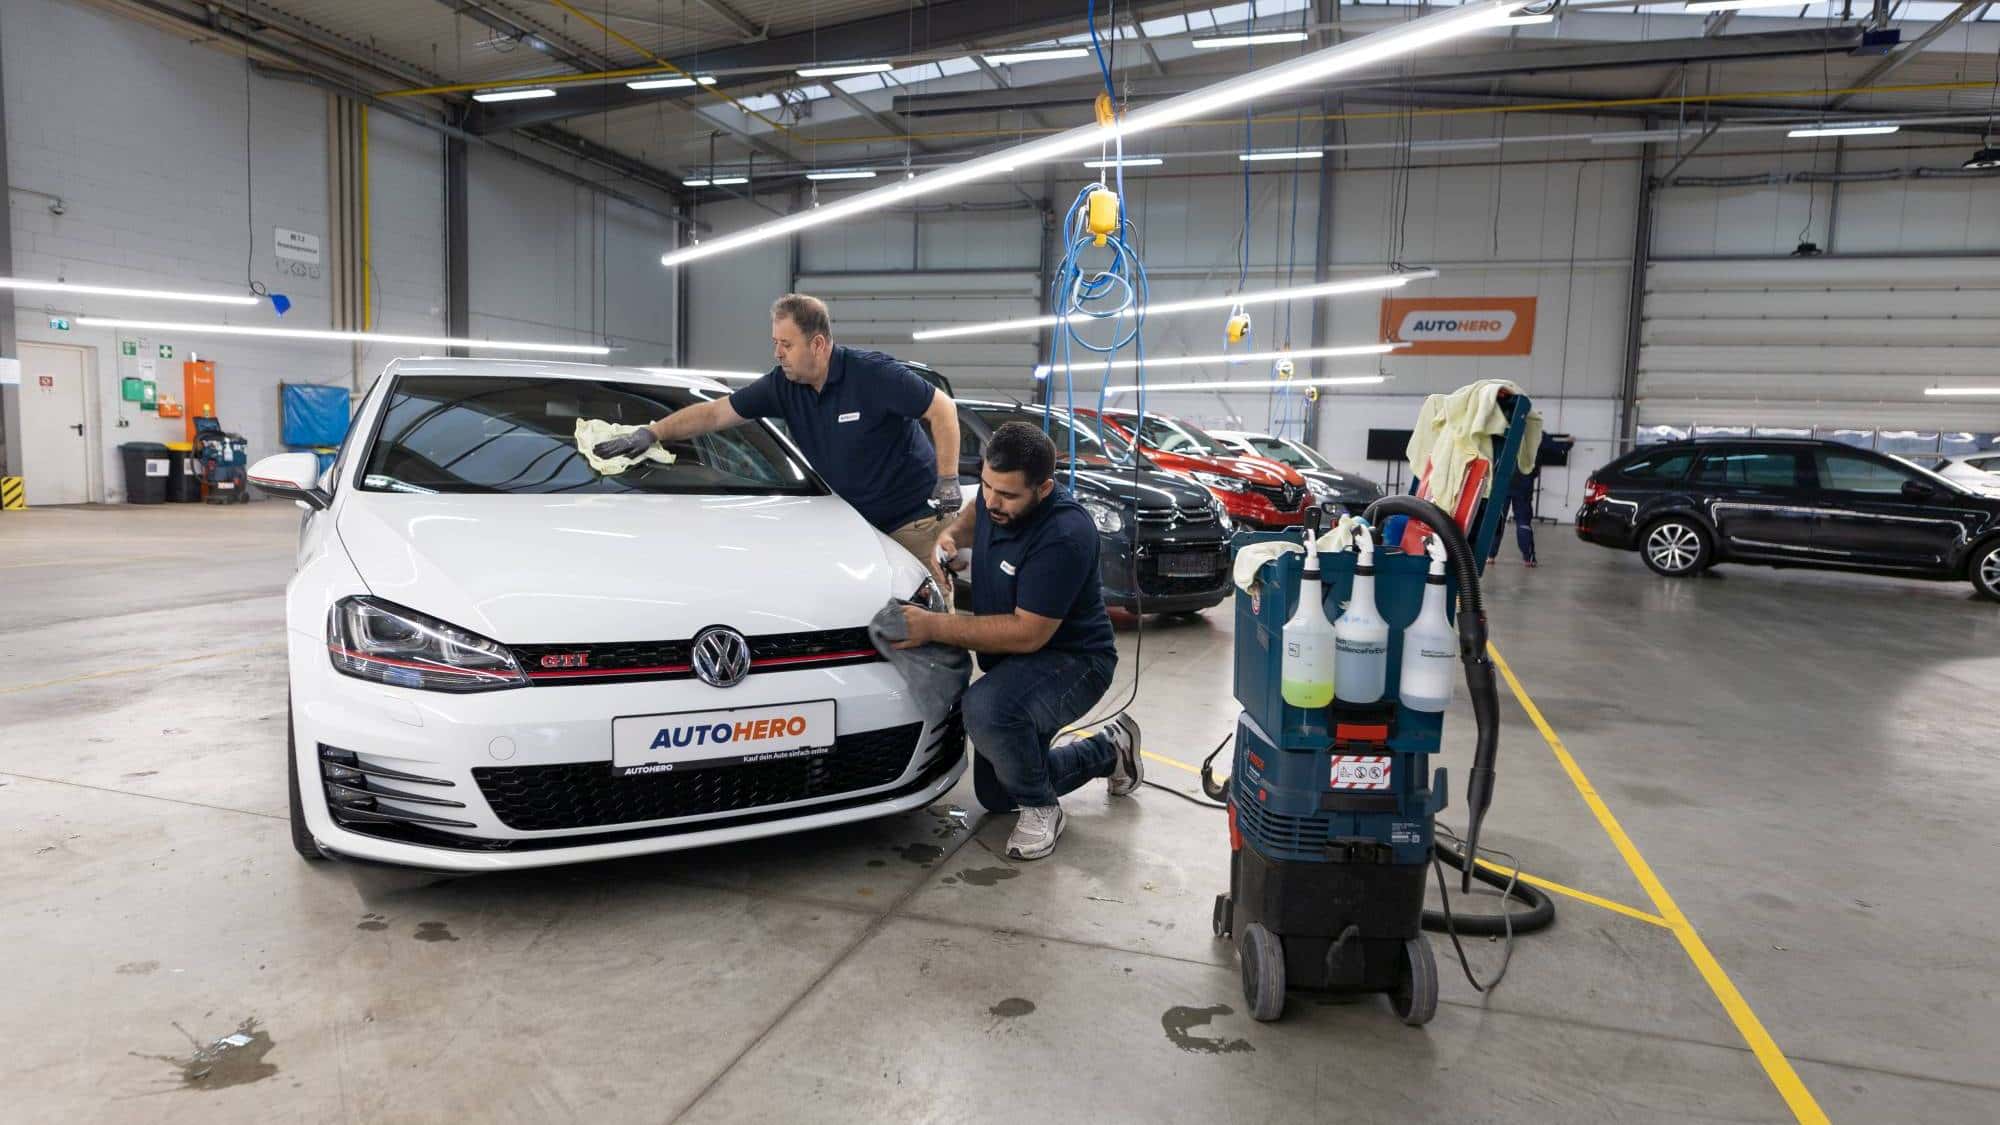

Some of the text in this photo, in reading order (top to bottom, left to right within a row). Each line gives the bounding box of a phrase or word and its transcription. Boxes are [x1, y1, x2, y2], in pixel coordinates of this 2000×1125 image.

[1413, 320, 1502, 332] AUTOHERO
[541, 653, 589, 667] GTI
[650, 716, 806, 749] AUTOHERO
[743, 754, 758, 762] Kauf
[759, 753, 772, 761] dein
[773, 752, 788, 760] Auto
[624, 764, 673, 775] AUTOHERO
